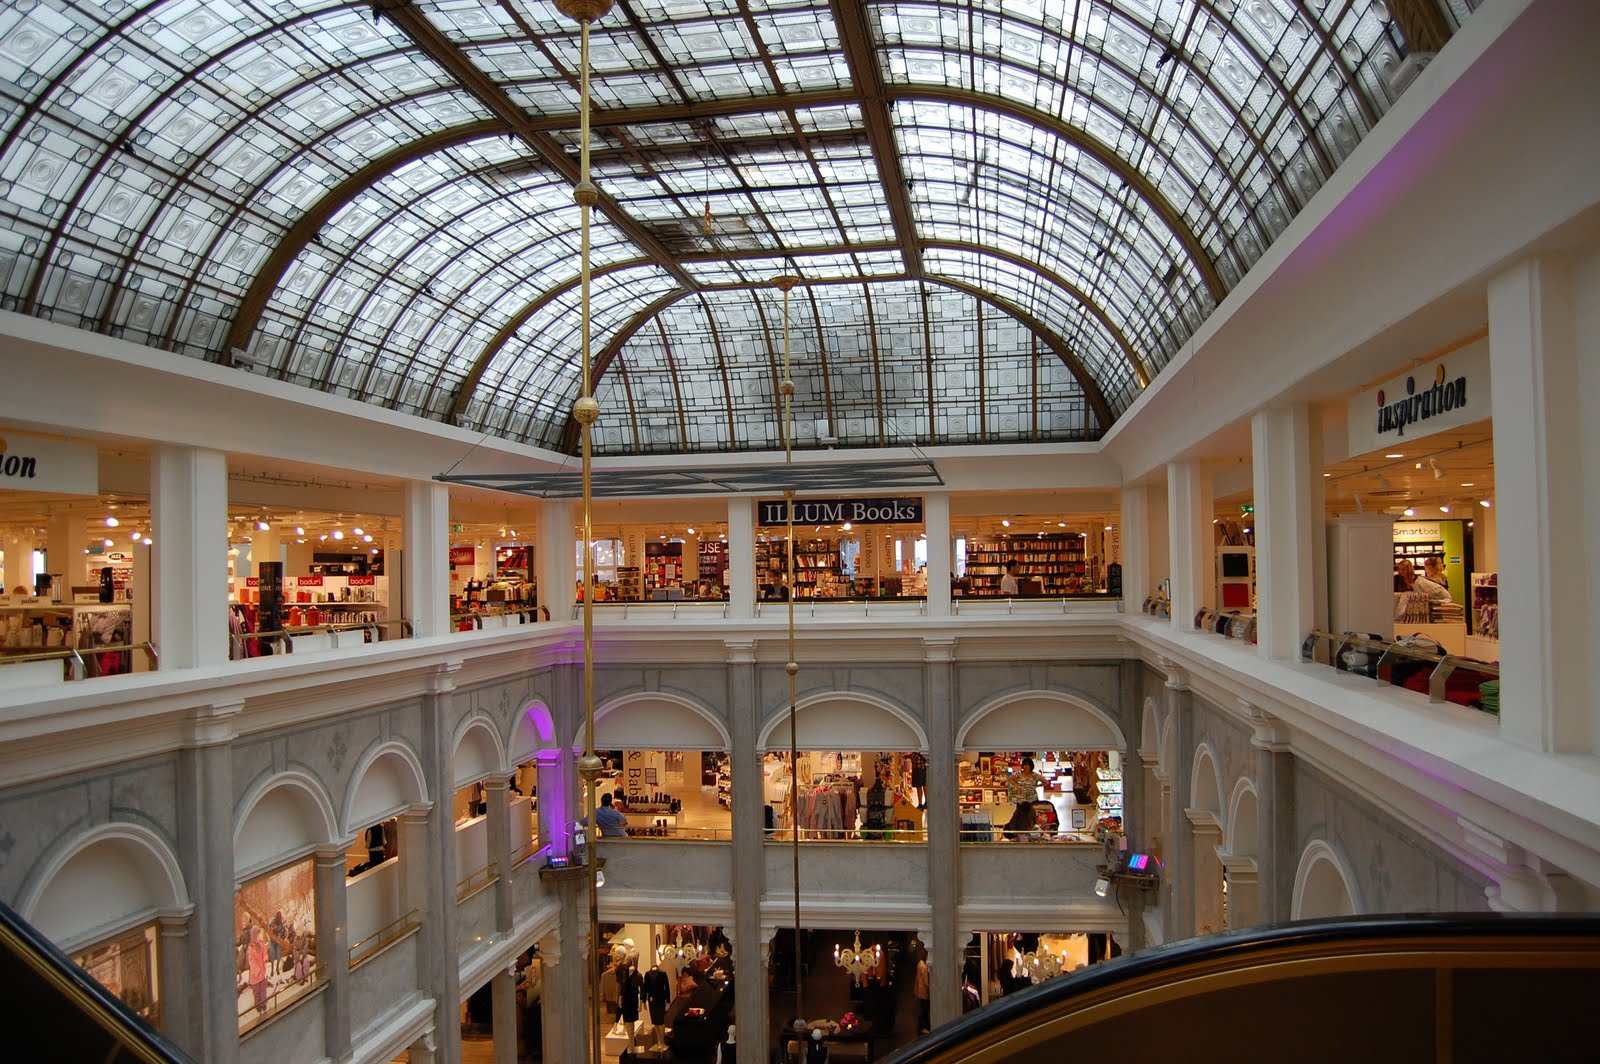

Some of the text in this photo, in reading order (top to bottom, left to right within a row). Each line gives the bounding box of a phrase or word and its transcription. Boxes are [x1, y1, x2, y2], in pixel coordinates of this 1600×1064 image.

[1377, 363, 1466, 436] inspiration
[765, 500, 916, 523] ILLUM Books
[1393, 528, 1439, 536] Smartbox
[699, 542, 721, 554] EJSE
[628, 768, 642, 796] Bab
